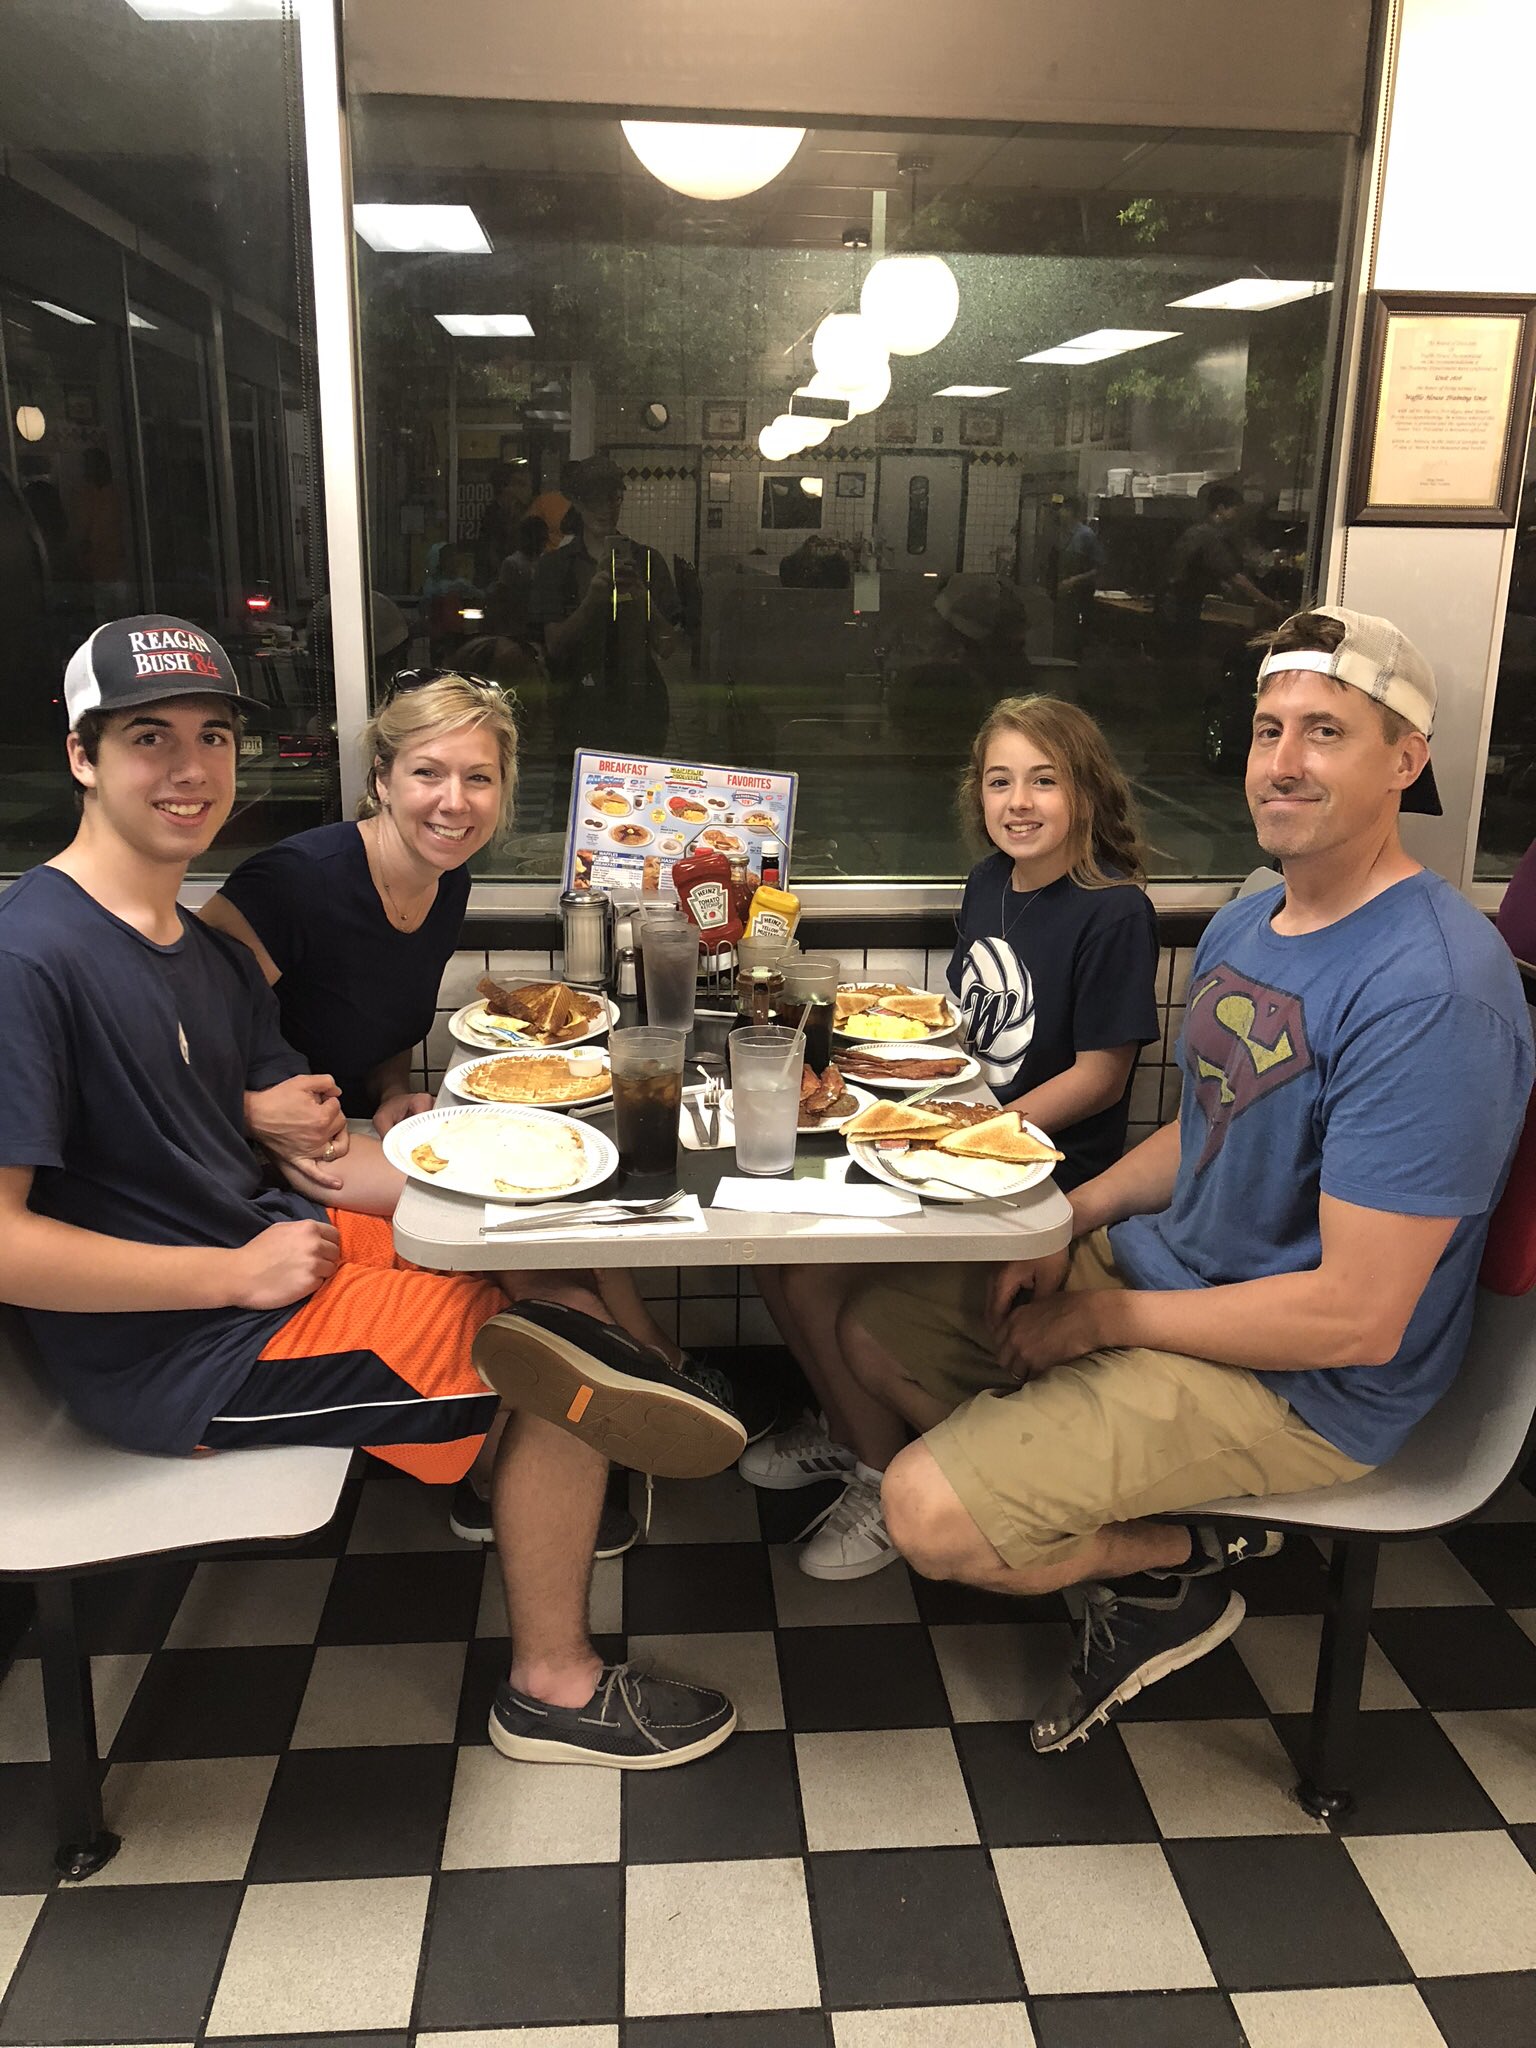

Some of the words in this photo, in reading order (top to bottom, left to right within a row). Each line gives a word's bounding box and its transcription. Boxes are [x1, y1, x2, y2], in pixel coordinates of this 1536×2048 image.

[128, 630, 212, 654] REAGAN
[133, 652, 192, 675] BUSH
[599, 760, 648, 776] BREAKFAST
[727, 775, 772, 790] FAVORITES
[697, 888, 717, 897] HEINZ
[698, 896, 720, 905] TOMATO
[761, 925, 779, 933] YELLOW
[764, 917, 782, 927] HEINZ
[962, 981, 1020, 1053] W
